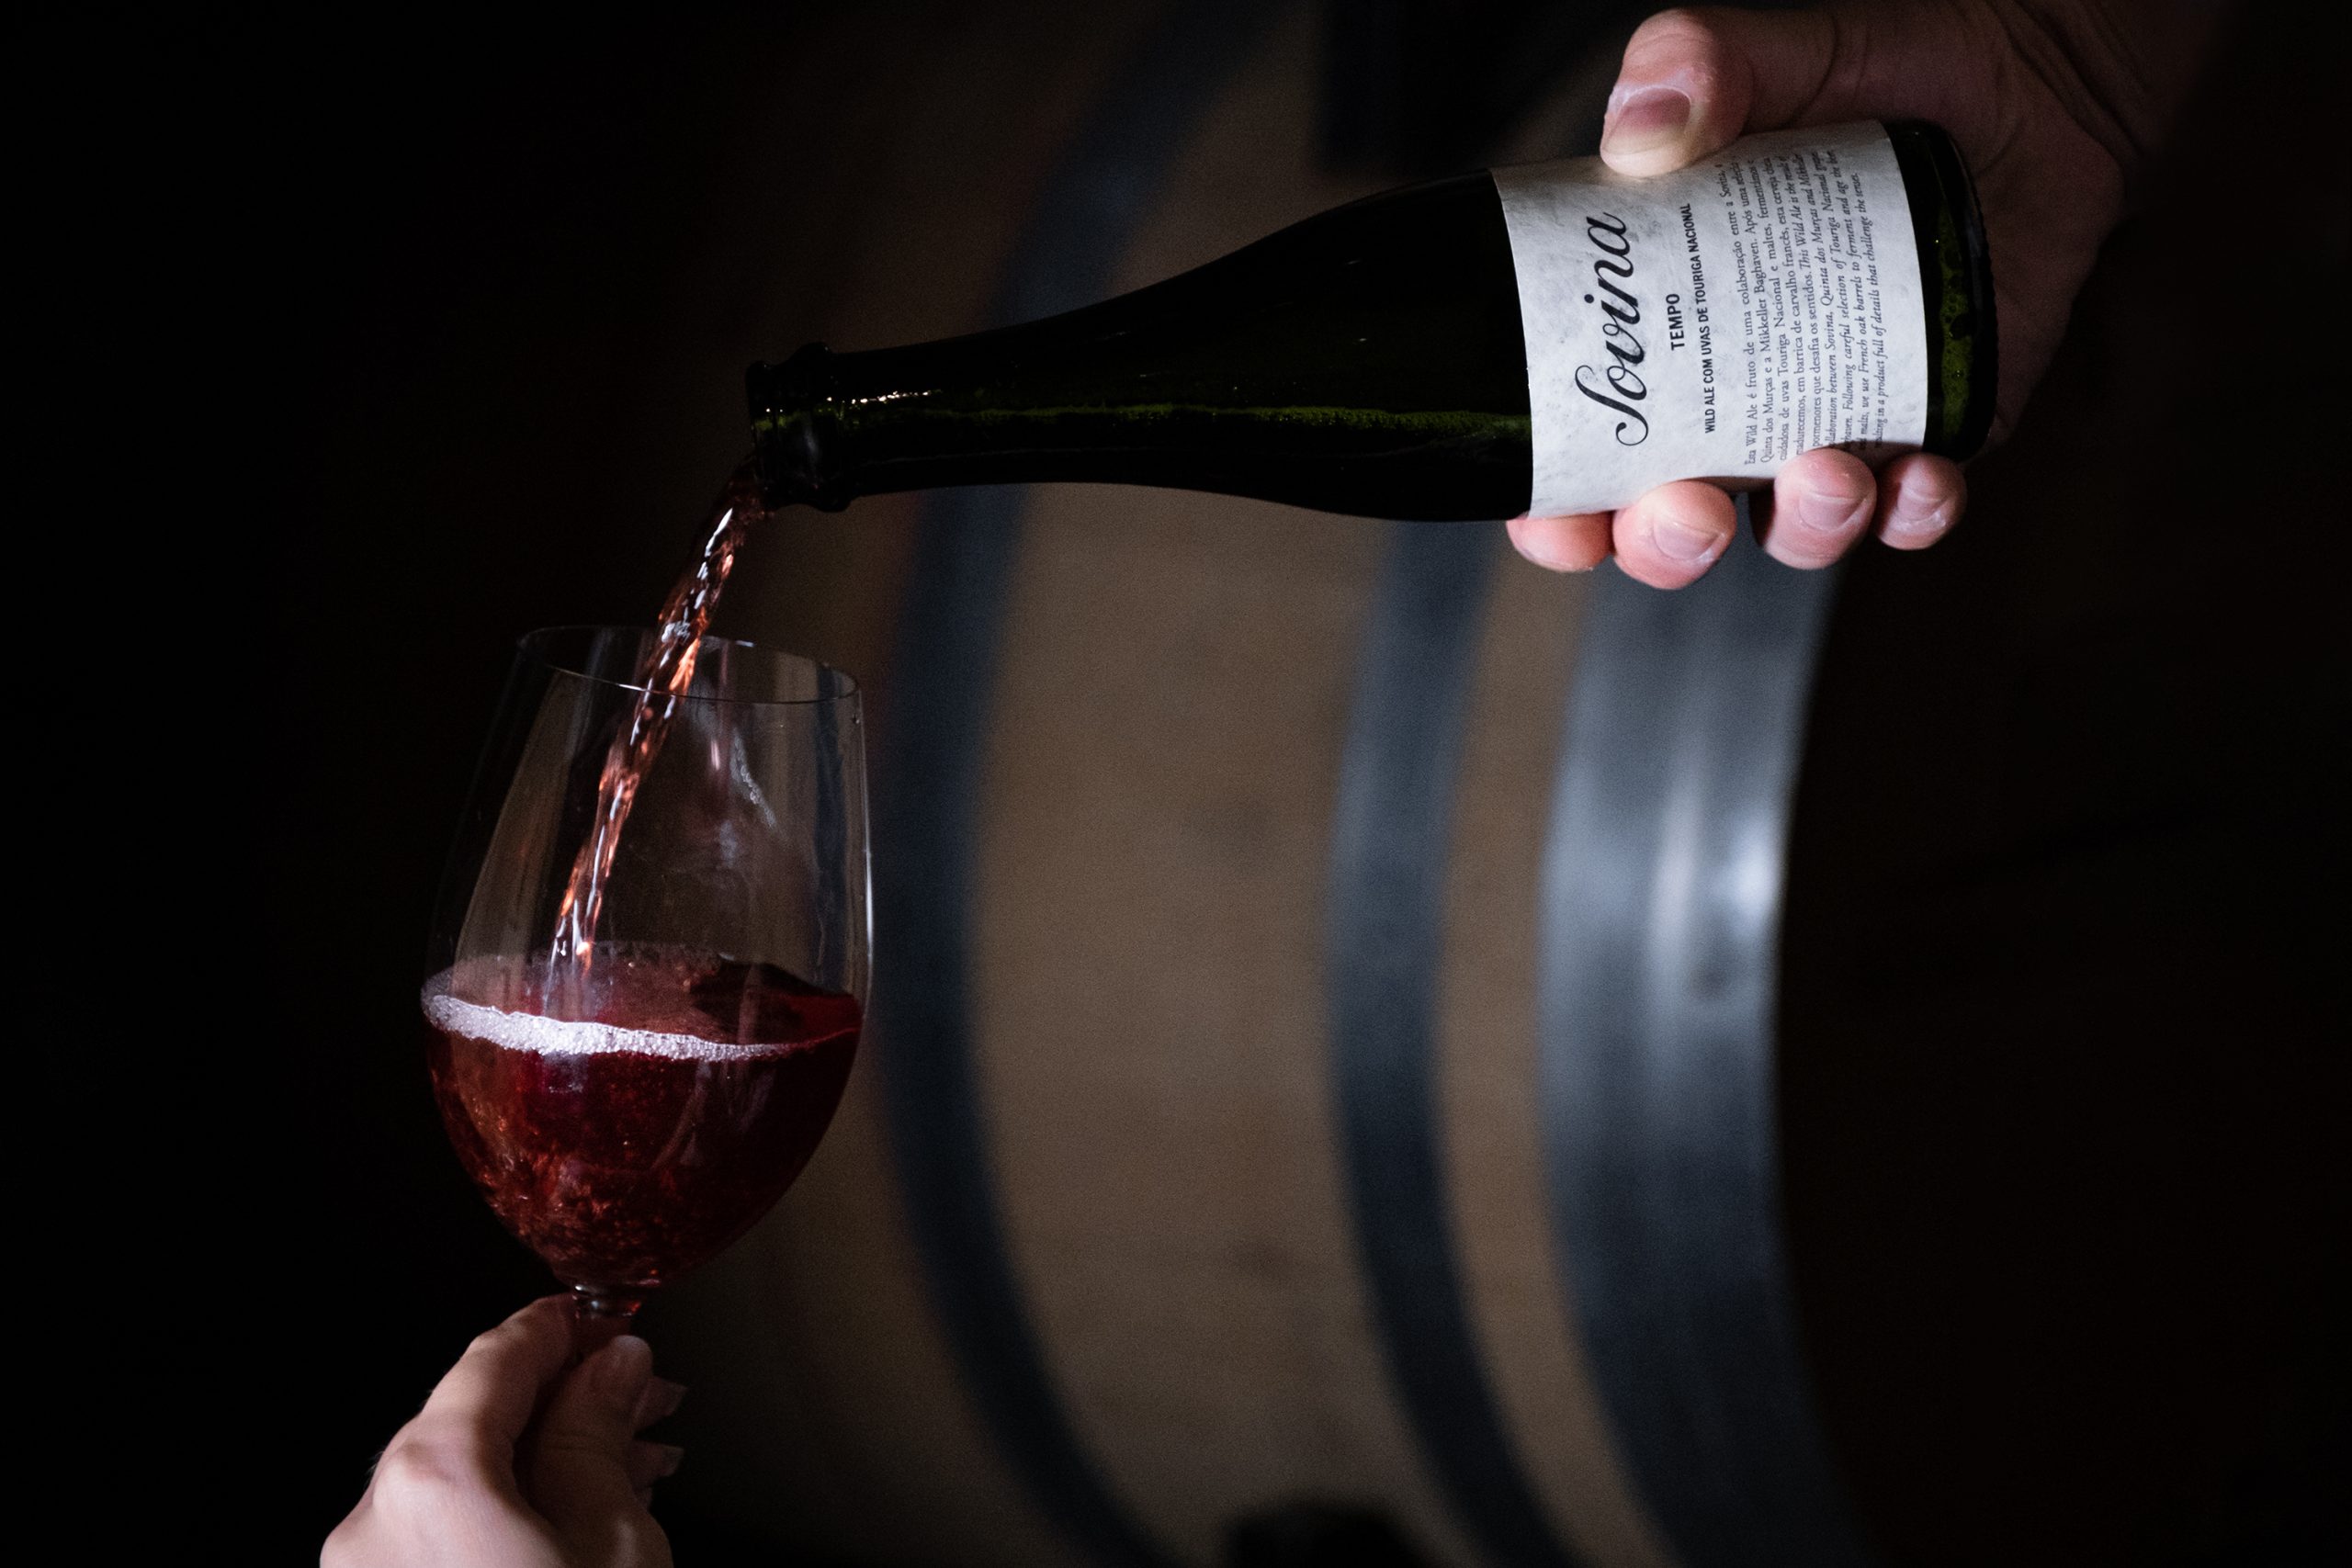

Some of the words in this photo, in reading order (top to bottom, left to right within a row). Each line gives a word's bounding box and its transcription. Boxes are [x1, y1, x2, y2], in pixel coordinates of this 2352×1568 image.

[1830, 167, 1841, 177] the
[1739, 187, 1749, 207] uma
[1768, 176, 1781, 204] cerveja
[1784, 183, 1796, 194] the
[1801, 189, 1815, 205] and
[1814, 175, 1833, 211] Nacional
[1837, 181, 1849, 194] age
[1777, 207, 1786, 224] esta
[1790, 206, 1803, 220] Ale
[1836, 197, 1850, 215] and
[1854, 199, 1866, 212] the
[1680, 204, 1699, 252] NACIONAL
[1728, 211, 1738, 235] entre
[1742, 210, 1758, 233] Após
[1792, 222, 1806, 246] Wild
[1810, 209, 1823, 243] Murças
[1763, 224, 1776, 259] maltes,
[1827, 218, 1840, 254] Touriga
[1845, 220, 1862, 259] ferment
[1860, 216, 1874, 261] challenge
[1751, 239, 1766, 294] Baghaven.
[1799, 250, 1810, 269] This
[1815, 247, 1826, 263] dos
[1831, 257, 1847, 269] of
[1852, 262, 1860, 271] to
[1690, 255, 1705, 304] TOURIGA
[1819, 268, 1834, 306] Quinta
[1867, 265, 1878, 285] that
[1769, 278, 1785, 327] Nacional
[1785, 271, 1800, 316] carvalho
[1803, 272, 1816, 319] sentidos.
[1837, 276, 1849, 319] selection
[1850, 276, 1865, 310] barrels
[1697, 308, 1709, 321] DE
[1869, 290, 1882, 323] details
[1575, 212, 1648, 446] Sovina
[1666, 294, 1685, 351] TEMPO
[1744, 311, 1753, 335] uma
[1757, 299, 1770, 352] Mikkeller
[1791, 321, 1802, 333] de
[1811, 323, 1817, 334] os
[1825, 311, 1836, 350] Sovina,
[1854, 316, 1867, 334] oak
[1871, 324, 1886, 336] of
[1700, 326, 1712, 355] UVAS
[1743, 342, 1754, 355] de
[1838, 323, 1854, 358] careful
[1872, 340, 1887, 359] full
[1777, 333, 1790, 377] Touriga
[1793, 337, 1804, 374] barrica
[1808, 338, 1820, 373] desafia
[1856, 340, 1869, 373] French
[1702, 358, 1713, 383] COM
[1746, 361, 1757, 387] fruto
[1826, 355, 1837, 393] between
[1874, 361, 1888, 397] product
[1704, 387, 1714, 405] ALE
[1763, 378, 1775, 413] Murças
[1798, 378, 1804, 392] em
[1814, 377, 1825, 394] que
[1842, 364, 1856, 410] Following
[1747, 404, 1757, 419] Ale
[1779, 408, 1789, 419] de
[1861, 396, 1869, 408] we
[1875, 408, 1884, 416] in
[1705, 409, 1714, 434] WILD
[1762, 418, 1773, 433] dos
[1813, 397, 1823, 446] pormenores
[1746, 425, 1757, 446] Wild
[1744, 450, 1756, 465] Esta
[1760, 436, 1774, 462] Quinta
